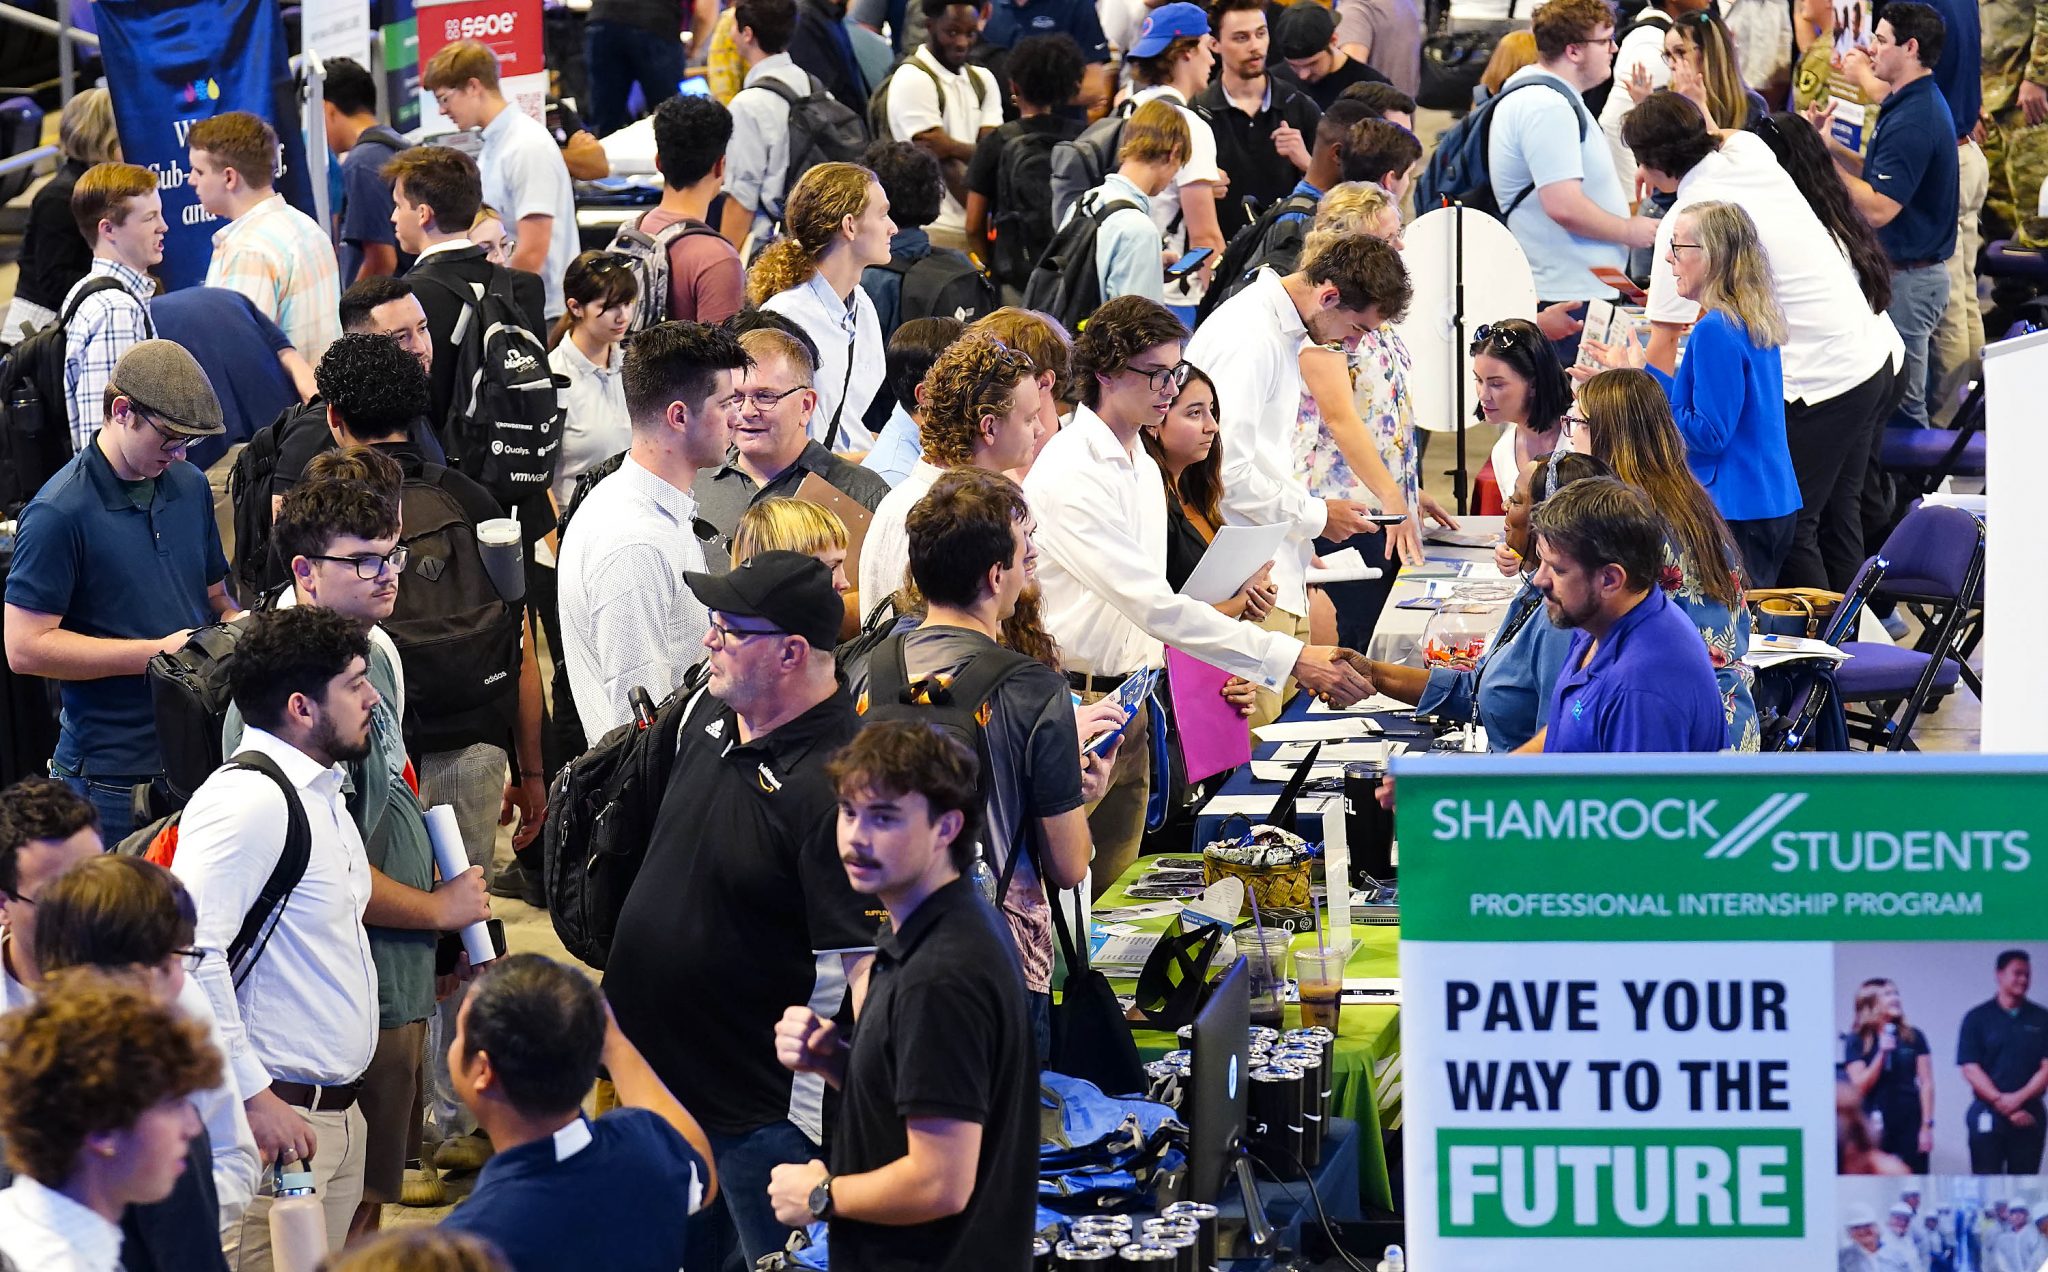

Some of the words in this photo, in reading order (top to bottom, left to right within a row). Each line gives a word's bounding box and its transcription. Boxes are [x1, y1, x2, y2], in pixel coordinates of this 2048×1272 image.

[484, 671, 507, 685] adidas
[1432, 798, 1720, 840] SHAMROCK
[1771, 830, 2032, 872] STUDENTS
[1469, 892, 1672, 917] PROFESSIONAL
[1678, 892, 1838, 916] INTERNSHIP
[1844, 892, 1983, 916] PROGRAM
[1446, 979, 1599, 1031] PAVE
[1622, 979, 1788, 1032] YOUR
[1445, 1059, 1571, 1111] WAY
[1588, 1059, 1661, 1112] TO
[1678, 1059, 1791, 1112] THE
[1449, 1144, 1791, 1228] FUTURE
